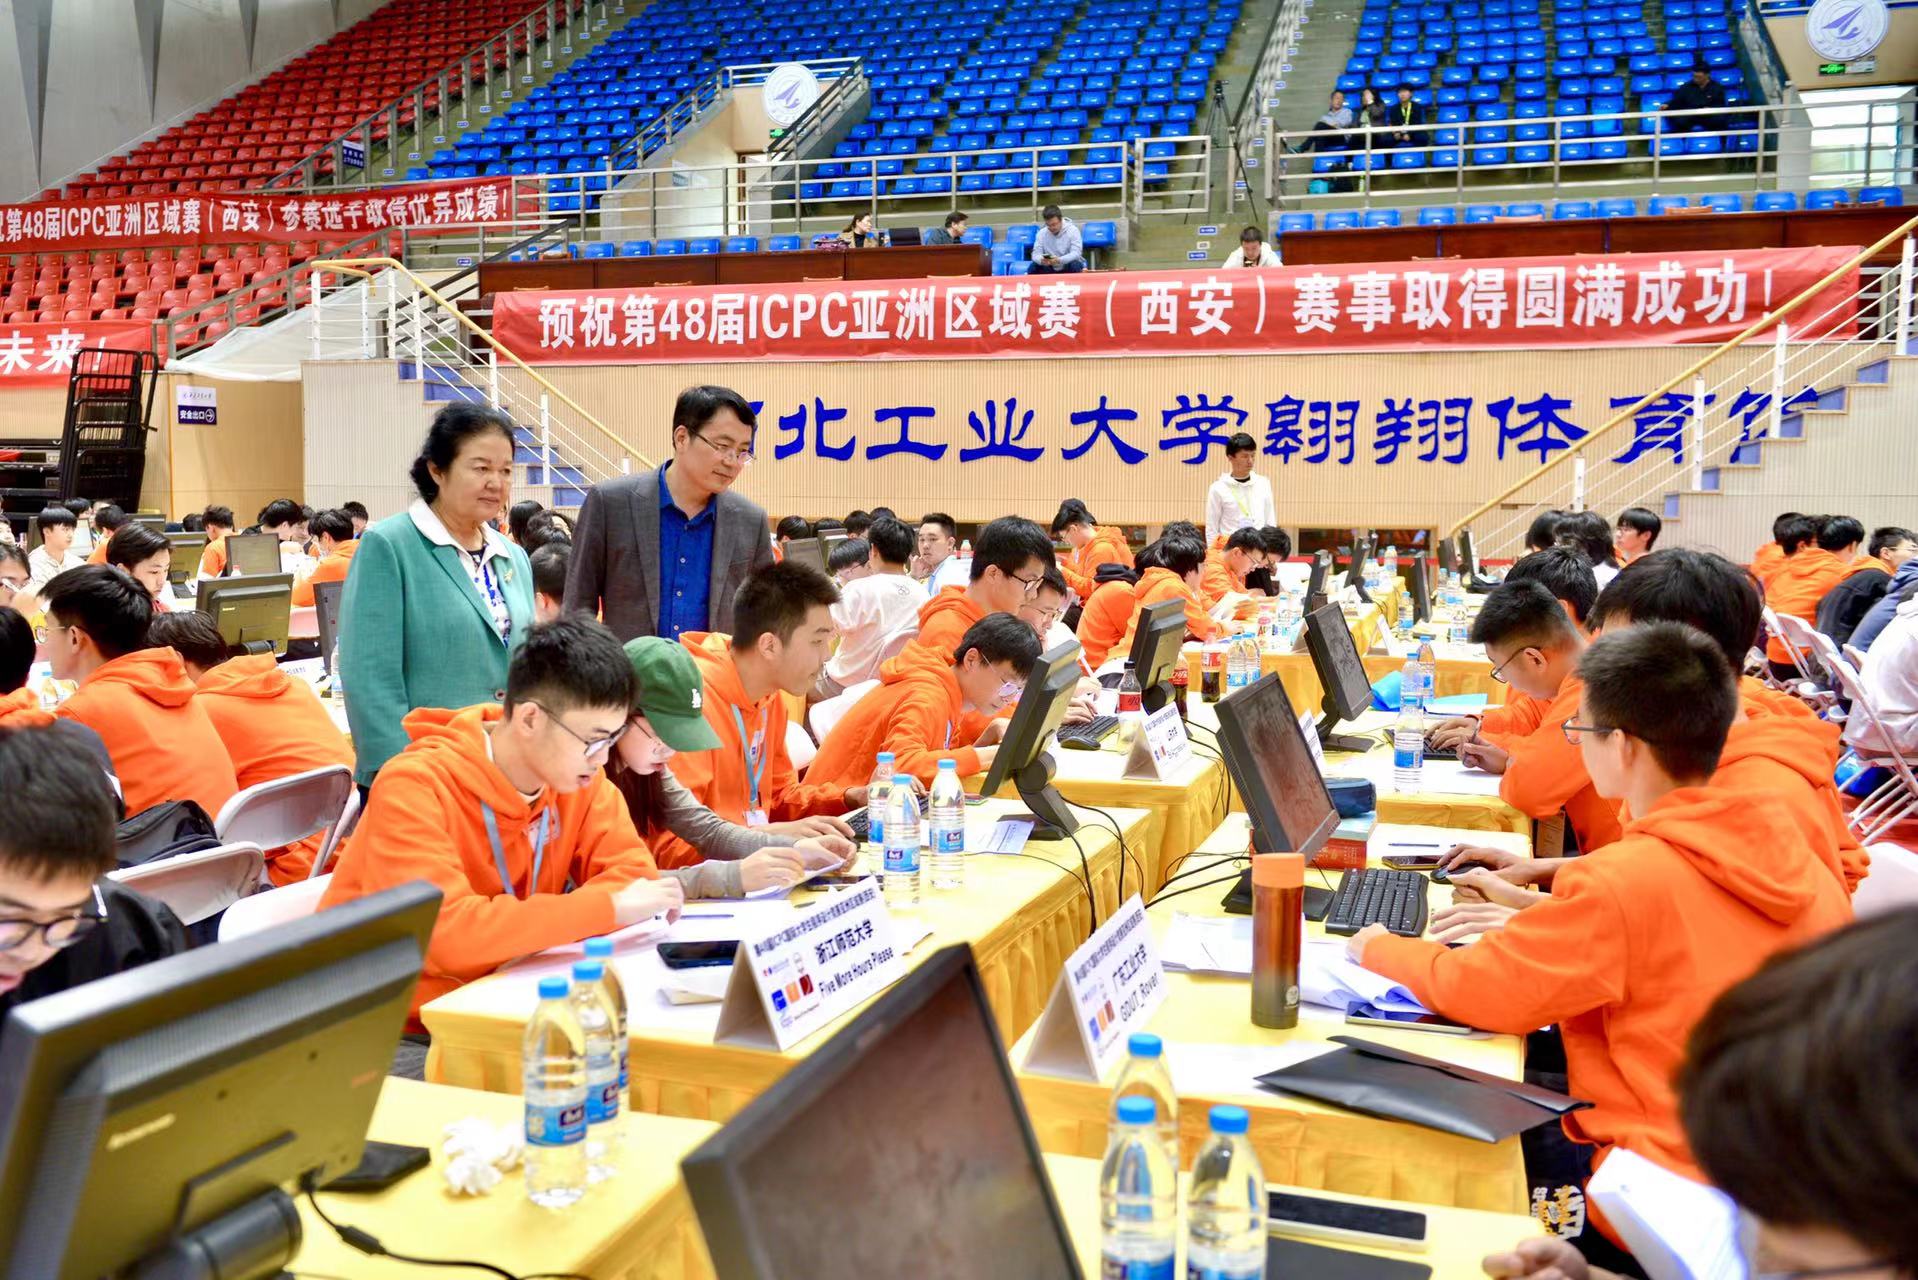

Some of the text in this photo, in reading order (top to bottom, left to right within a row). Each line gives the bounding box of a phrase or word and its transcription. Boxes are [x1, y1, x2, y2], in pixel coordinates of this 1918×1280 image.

[0, 185, 507, 242] 第48届ICPC亚洲区域赛（西安）参赛选手取得优异成绩！
[539, 258, 1772, 348] 预祝第48届ICPC亚洲区域赛（西安）赛事取得圆满成功！
[749, 391, 1818, 466] 北工业大学翱翔体育
[814, 919, 873, 964] 浙江师范大学
[871, 947, 894, 968] Please
